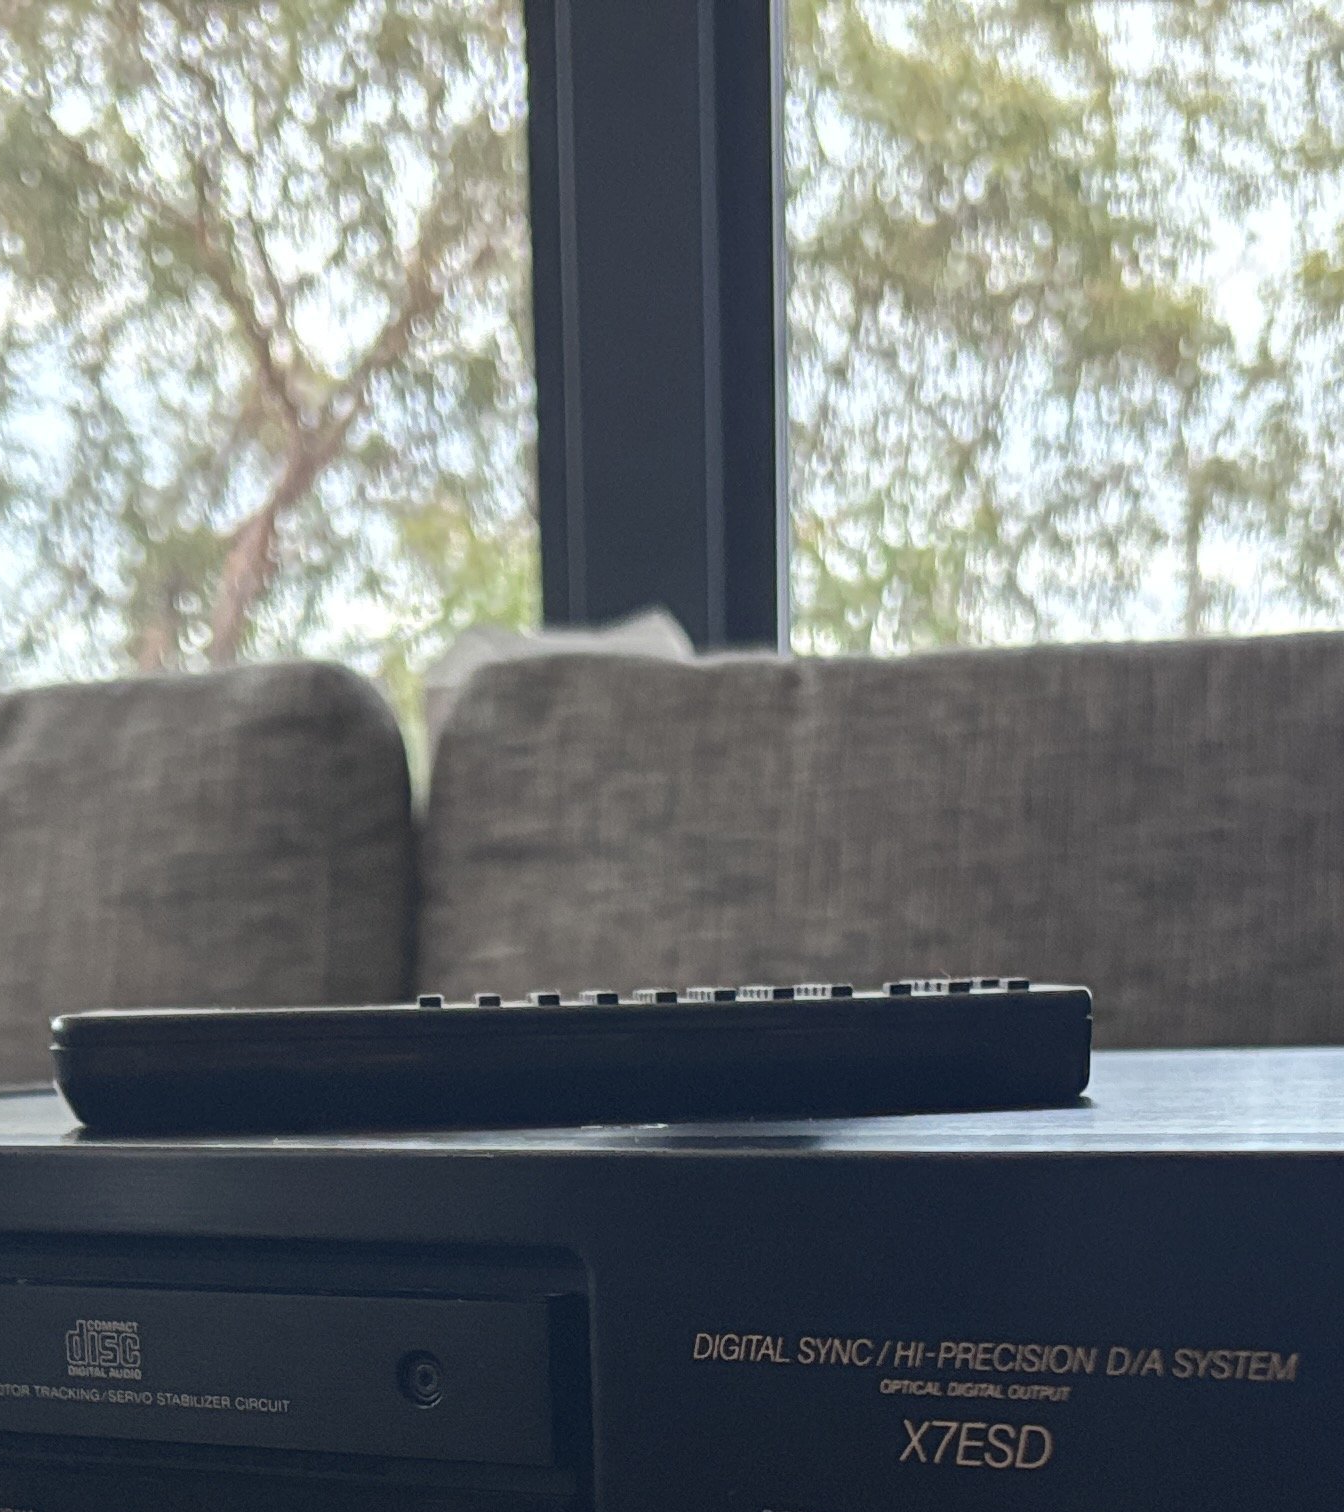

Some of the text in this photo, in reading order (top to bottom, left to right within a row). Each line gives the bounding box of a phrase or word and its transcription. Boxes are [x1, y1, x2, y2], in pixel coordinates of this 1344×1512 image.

[692, 1333, 791, 1363] DIGITAL
[1106, 1347, 1163, 1377] D/A
[1172, 1348, 1300, 1382] SYSTEM
[67, 1365, 142, 1380] DIGITAL AUDIO
[879, 1379, 1072, 1402] OPTICAL DIGITAL OUTPUT
[156, 1393, 231, 1409] STABILIZER
[235, 1397, 290, 1412] CIRCUIT
[898, 1419, 1054, 1470] X7ESD
